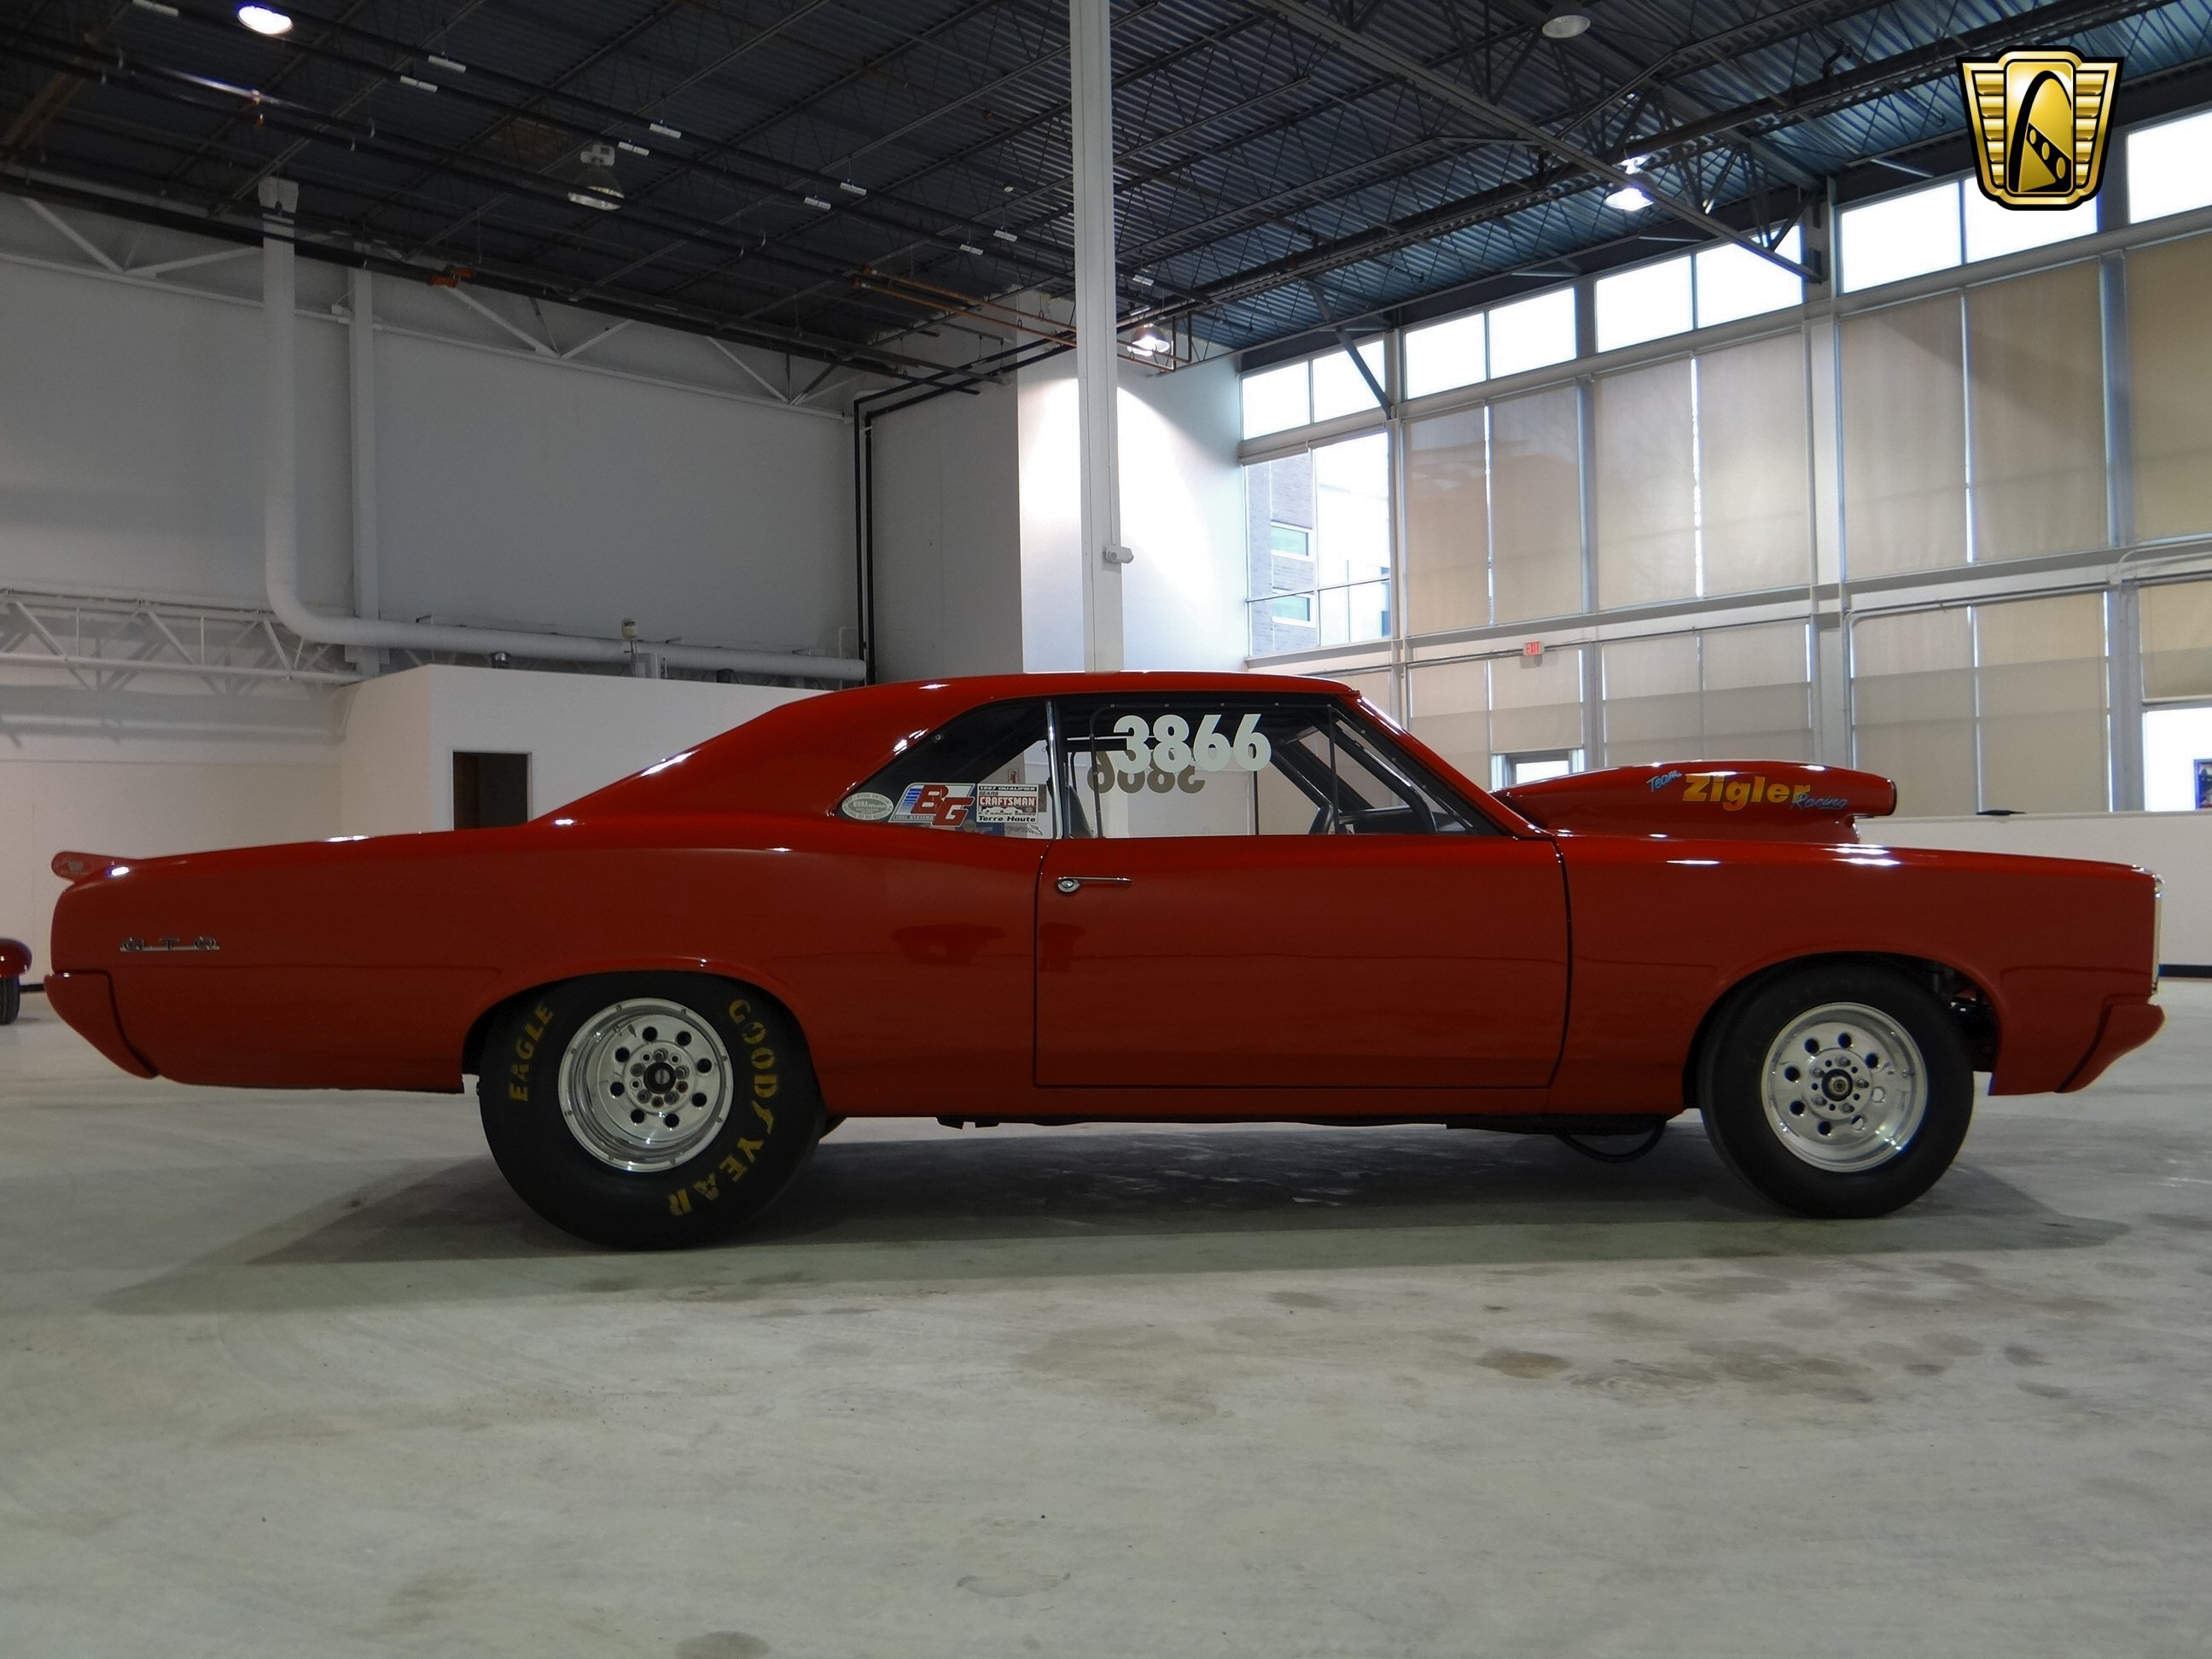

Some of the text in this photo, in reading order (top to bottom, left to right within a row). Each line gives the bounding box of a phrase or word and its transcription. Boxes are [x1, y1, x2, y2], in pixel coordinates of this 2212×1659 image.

[1525, 641, 1540, 655] EXIT
[1113, 713, 1272, 773] 3866
[910, 784, 975, 826] BG
[980, 796, 1035, 806] CRAFTSMAN
[1646, 770, 1850, 811] Team Zigler Racing
[509, 1002, 554, 1102] EAGLE
